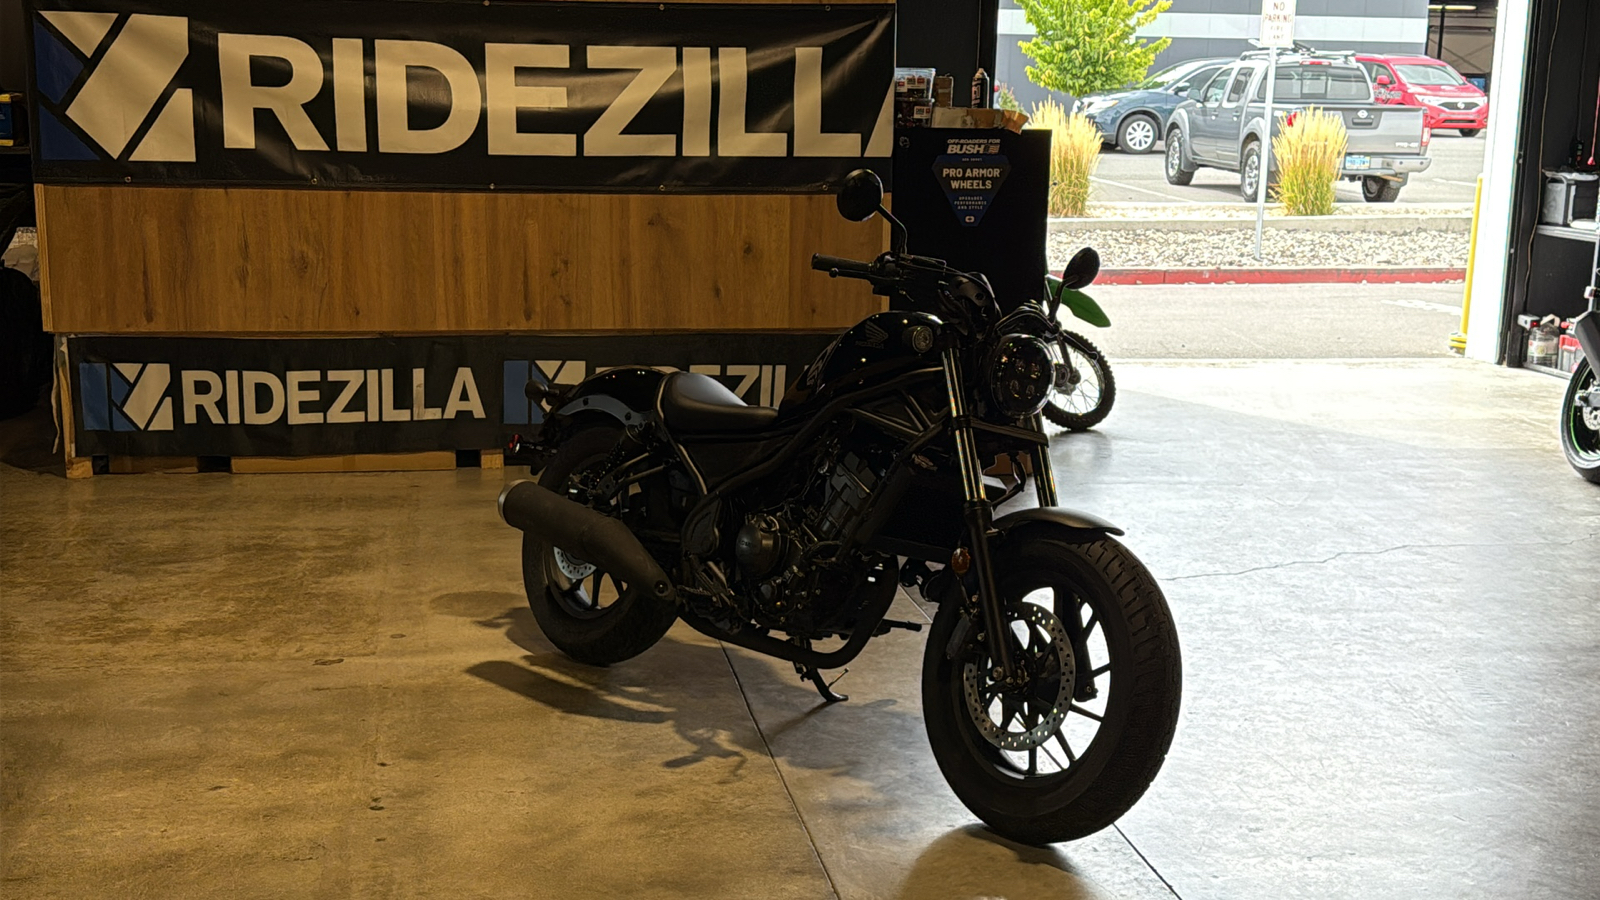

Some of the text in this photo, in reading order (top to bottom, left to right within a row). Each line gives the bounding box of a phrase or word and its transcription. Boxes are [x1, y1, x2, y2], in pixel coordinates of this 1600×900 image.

[1273, 2, 1285, 11] NO
[1264, 13, 1292, 23] PARKING
[947, 144, 985, 154] BUSH
[942, 168, 1001, 178] PRO ARMOR
[950, 180, 993, 189] WHEELS
[181, 366, 486, 426] RIDEZILLA
